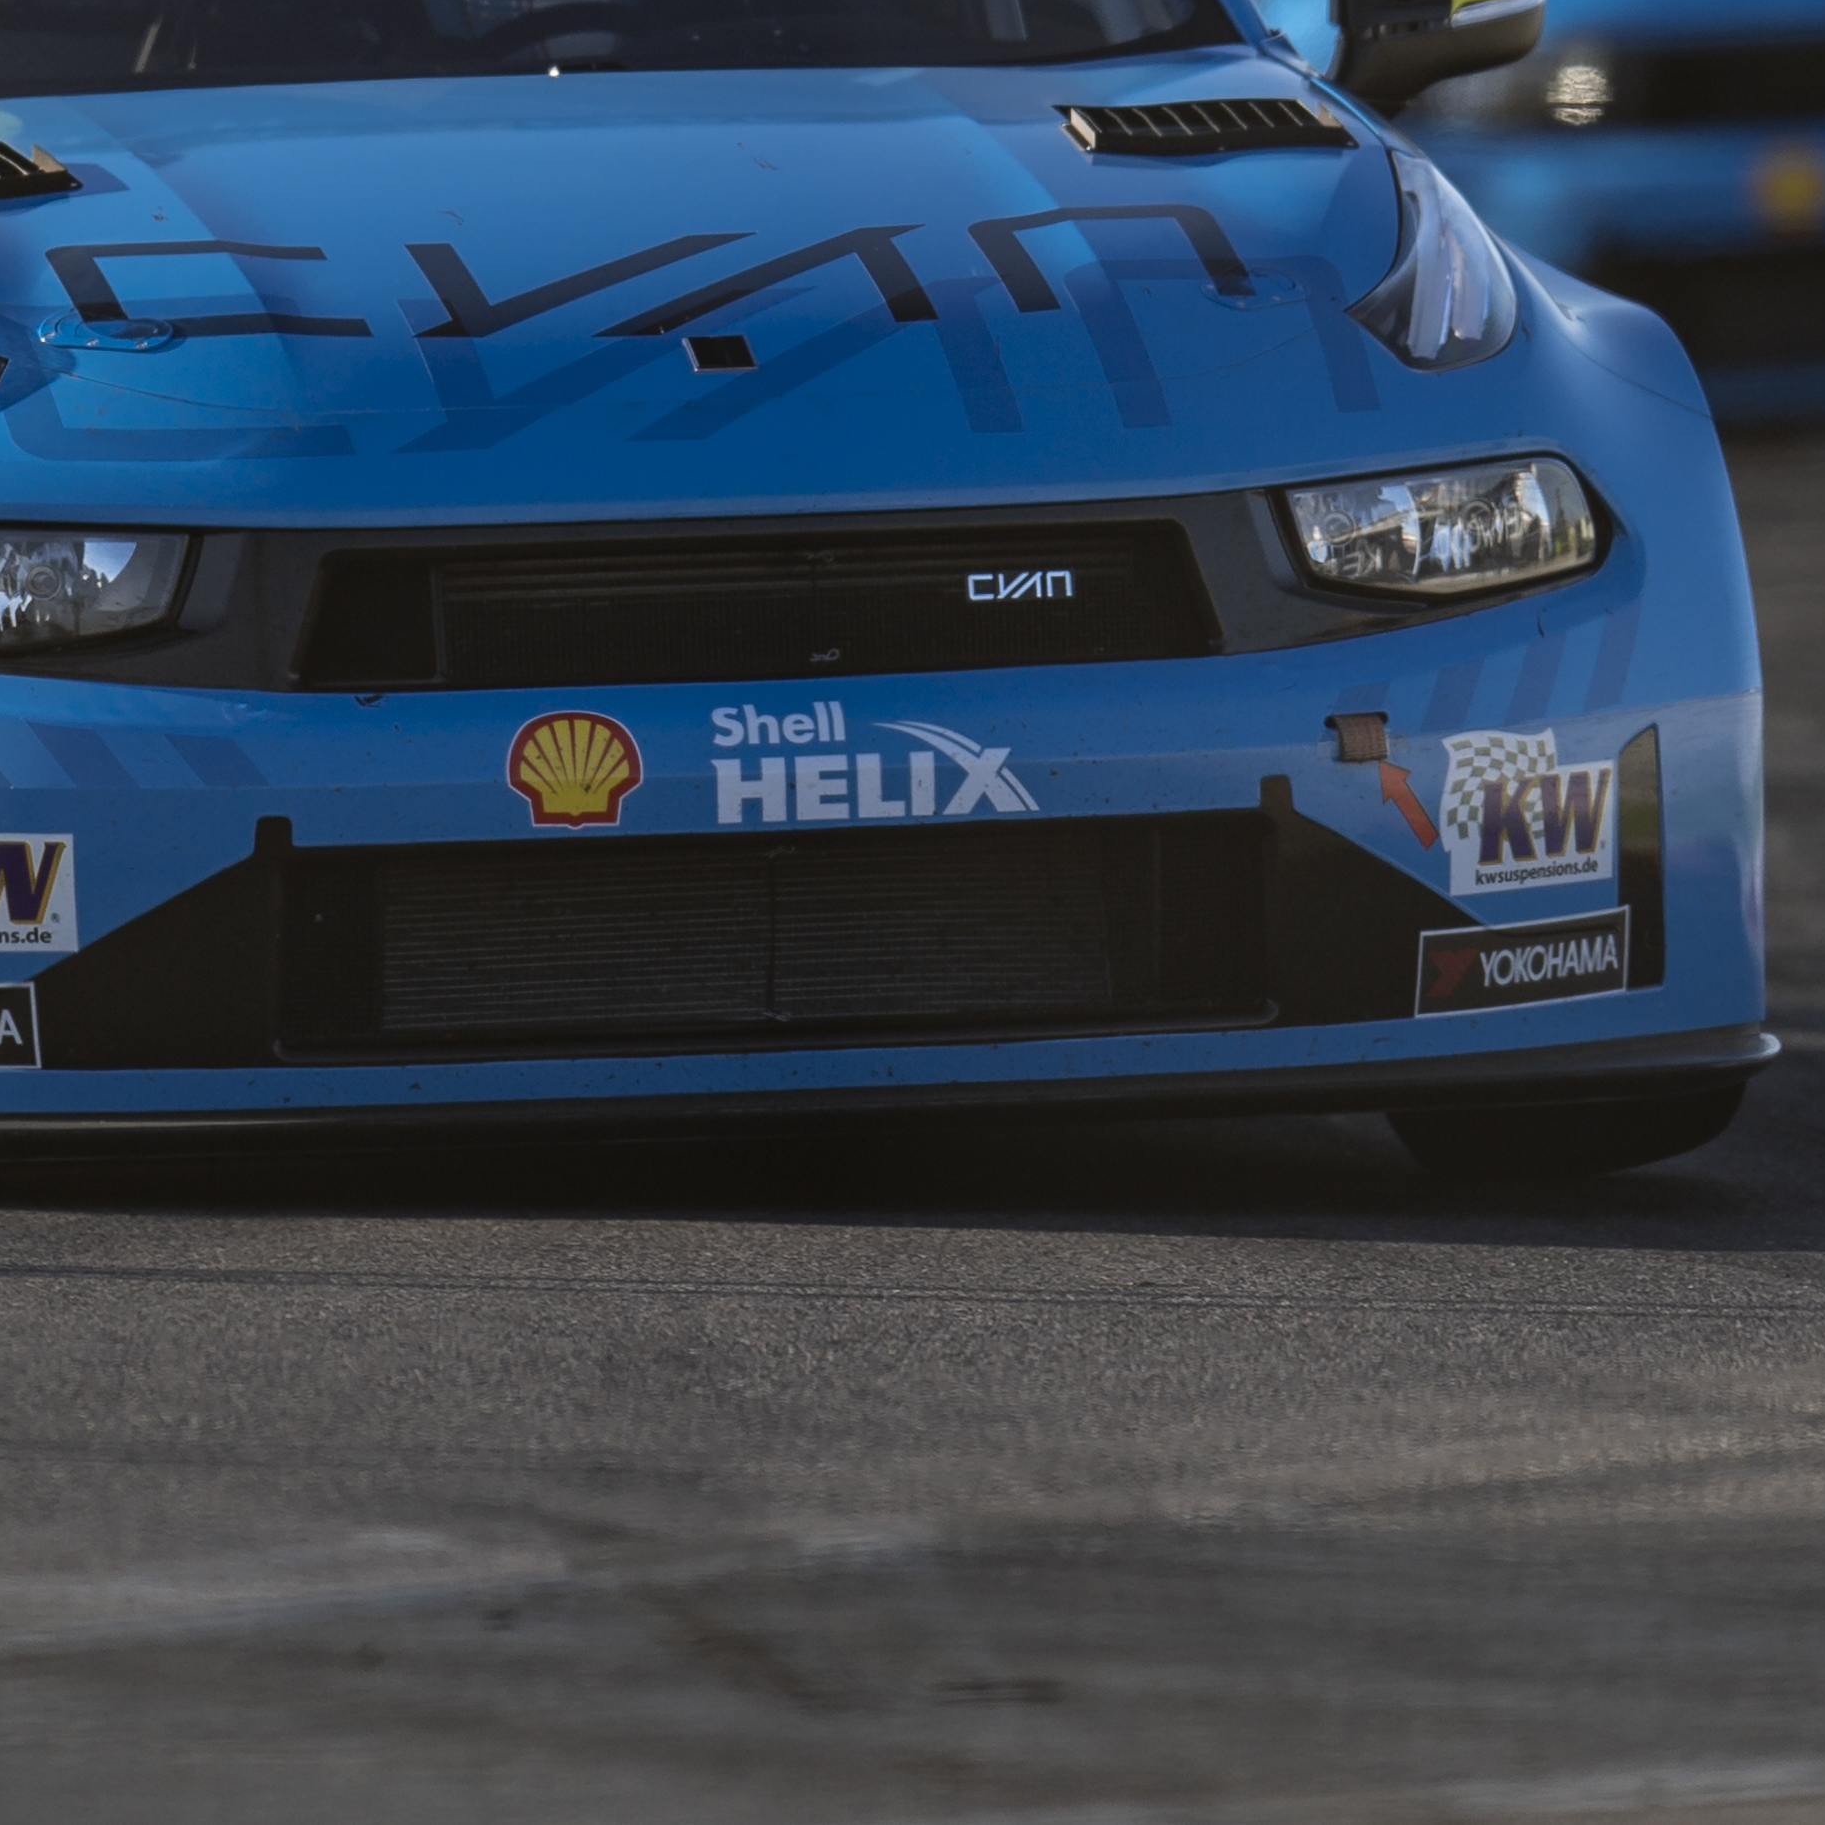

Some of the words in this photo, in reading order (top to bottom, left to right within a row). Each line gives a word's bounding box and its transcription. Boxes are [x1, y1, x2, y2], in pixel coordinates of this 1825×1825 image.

[968, 570, 1073, 601] CYAN
[712, 701, 846, 747] Shell
[711, 721, 1040, 824] HELIX
[1479, 767, 1612, 866] KW
[1475, 856, 1599, 887] kwsuspensions.de
[1479, 934, 1619, 988] YOKOHAMA
